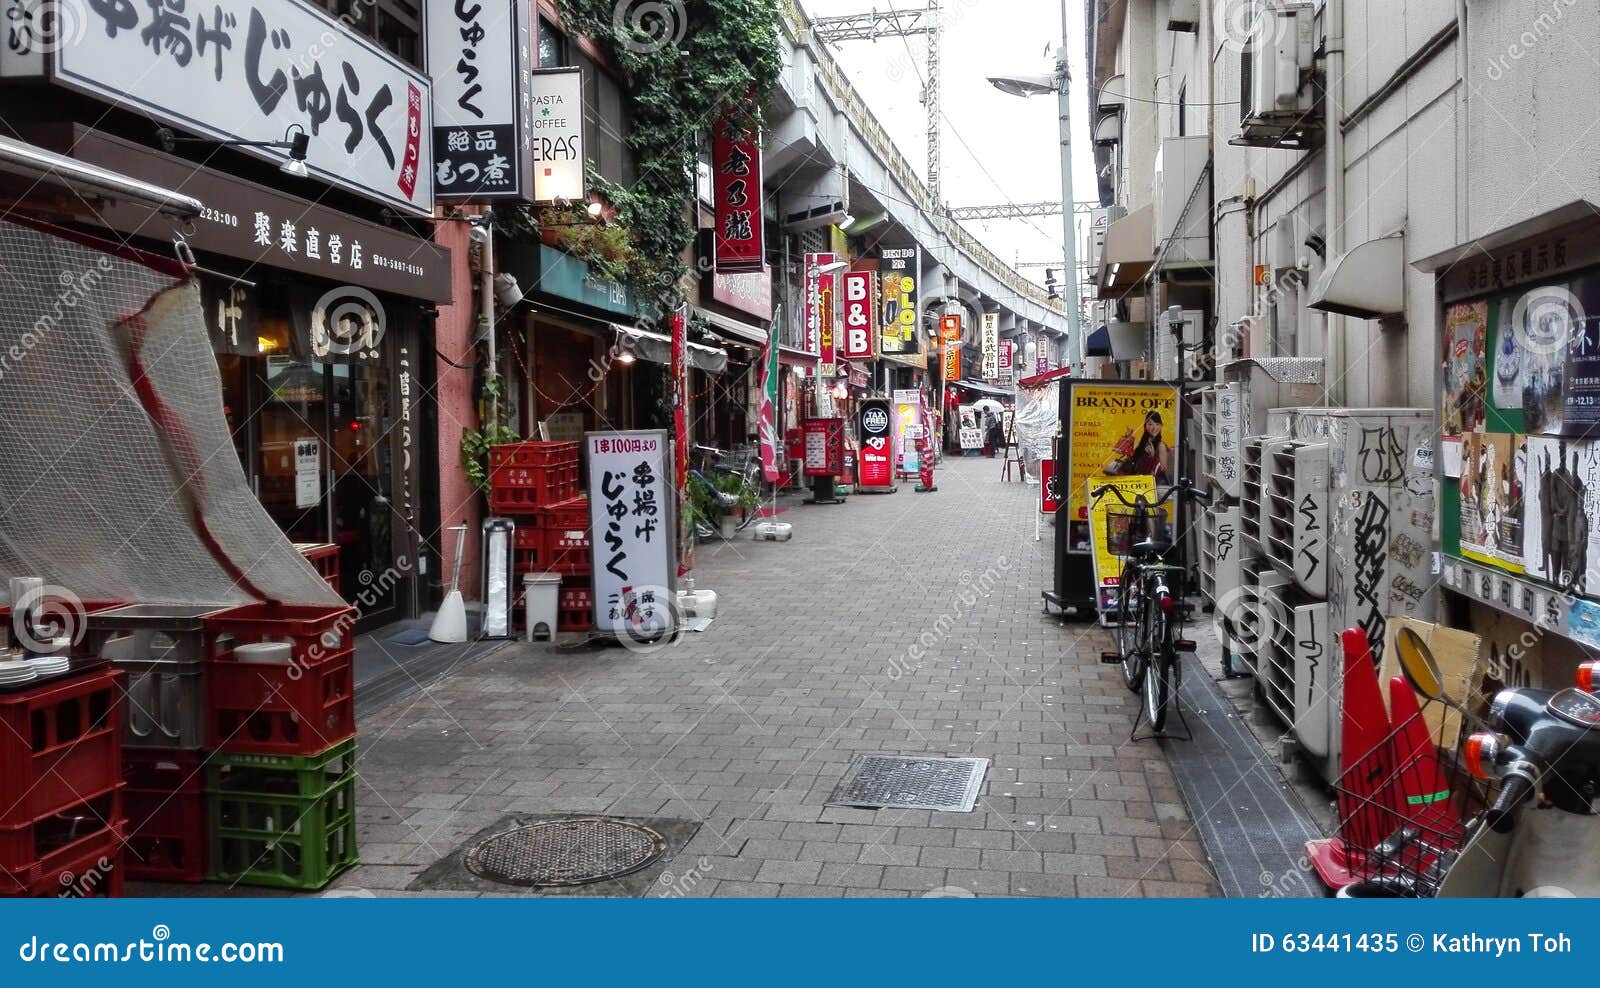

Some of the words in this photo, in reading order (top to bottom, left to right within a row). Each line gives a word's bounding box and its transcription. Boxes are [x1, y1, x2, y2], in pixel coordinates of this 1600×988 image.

[534, 119, 567, 129] OFFEE
[447, 130, 497, 152] 絶品
[533, 136, 579, 162] ERAS
[436, 153, 511, 186] もつ煮
[254, 211, 362, 270] 聚楽直営店
[847, 276, 867, 353] B&B
[900, 276, 916, 341] SLOT
[1076, 397, 1136, 408] BRAND
[1141, 398, 1175, 409] OFF
[595, 439, 657, 455] 1串100円より
[632, 460, 659, 544] 串揚げ
[601, 471, 630, 582] じゅらく
